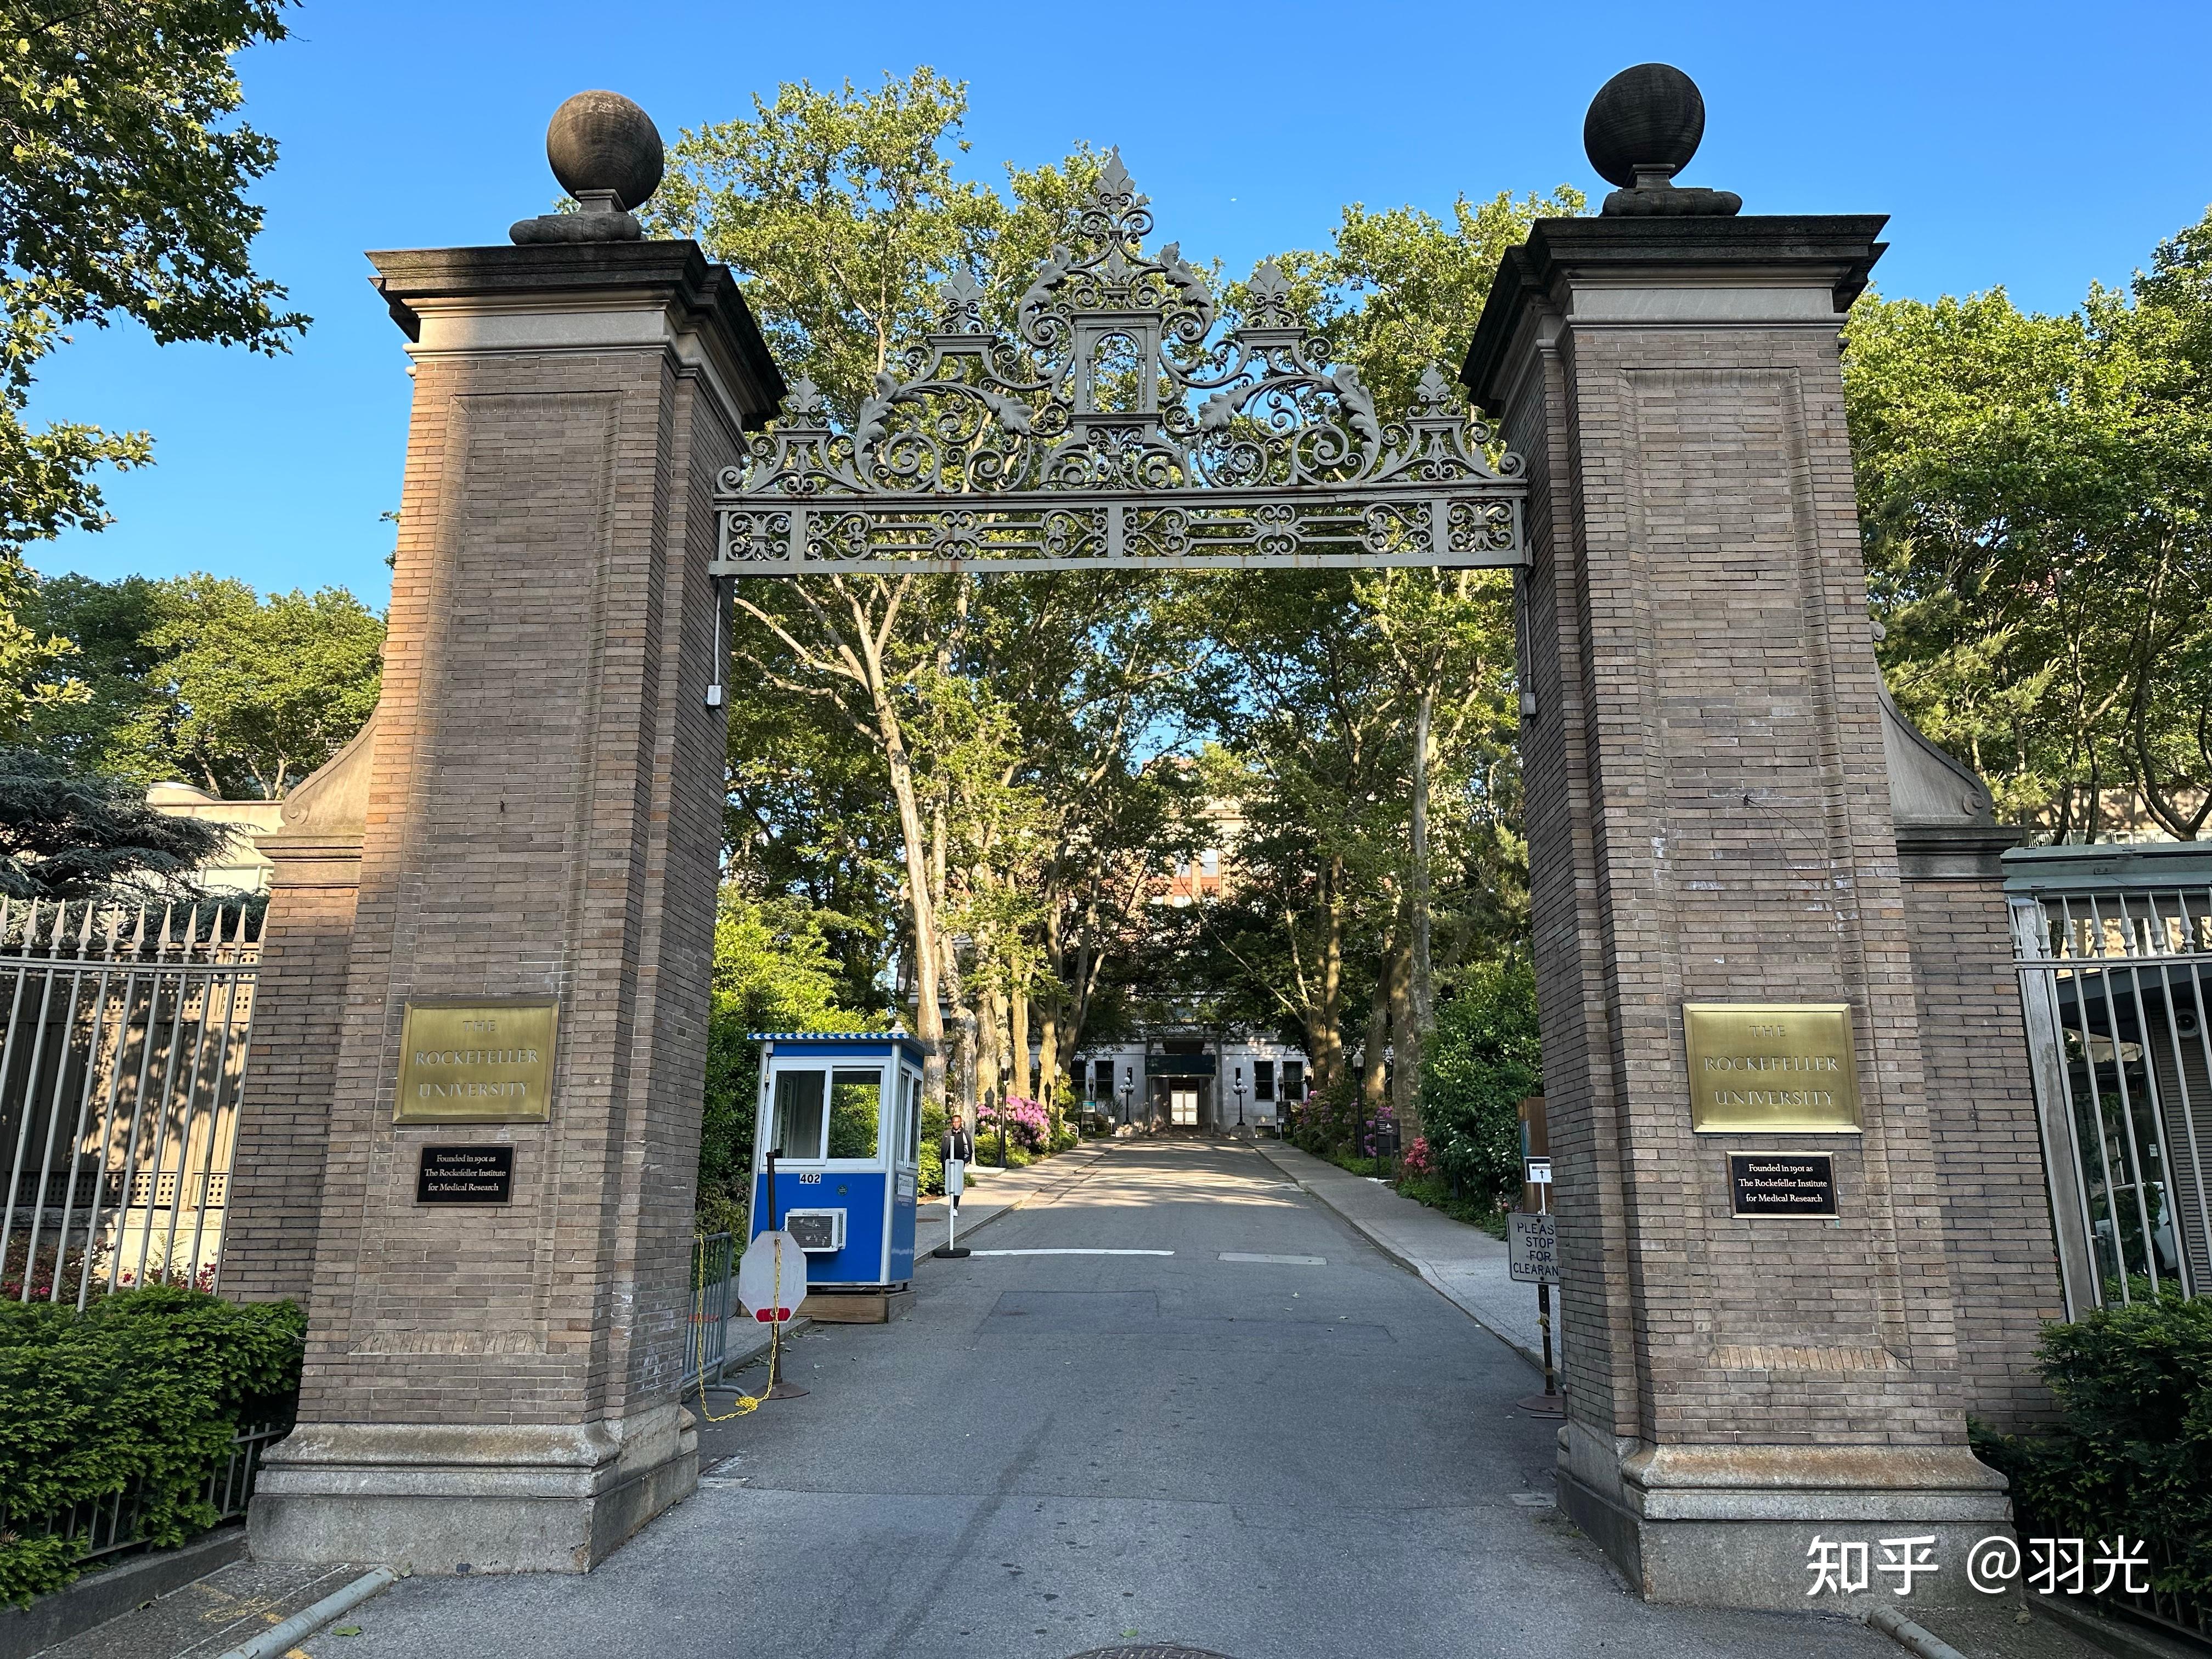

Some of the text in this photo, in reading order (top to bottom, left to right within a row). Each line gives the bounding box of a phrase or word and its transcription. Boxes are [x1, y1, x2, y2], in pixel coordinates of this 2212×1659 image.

[462, 1020, 496, 1032] THE
[1749, 1025, 1786, 1037] THE
[415, 1048, 539, 1065] ROCKEFELLER
[1705, 1056, 1839, 1071] ROCKEFELLER
[418, 1081, 530, 1097] UNIVERSITY
[1714, 1090, 1834, 1105] UNIVERSITY
[436, 1154, 466, 1162] Founded
[1748, 1164, 1780, 1172] Founded
[1790, 1166, 1804, 1174] 1901
[800, 1174, 820, 1183] 402
[1738, 1178, 1827, 1187] The Rockefeller Institute
[428, 1183, 499, 1191] for Medical Research
[1746, 1193, 1823, 1202] for Medical Research
[1517, 1222, 1554, 1235] PLEAS
[1526, 1236, 1554, 1249] STOP
[1530, 1250, 1551, 1262] FOR
[1513, 1262, 1559, 1277] CLEARAN
